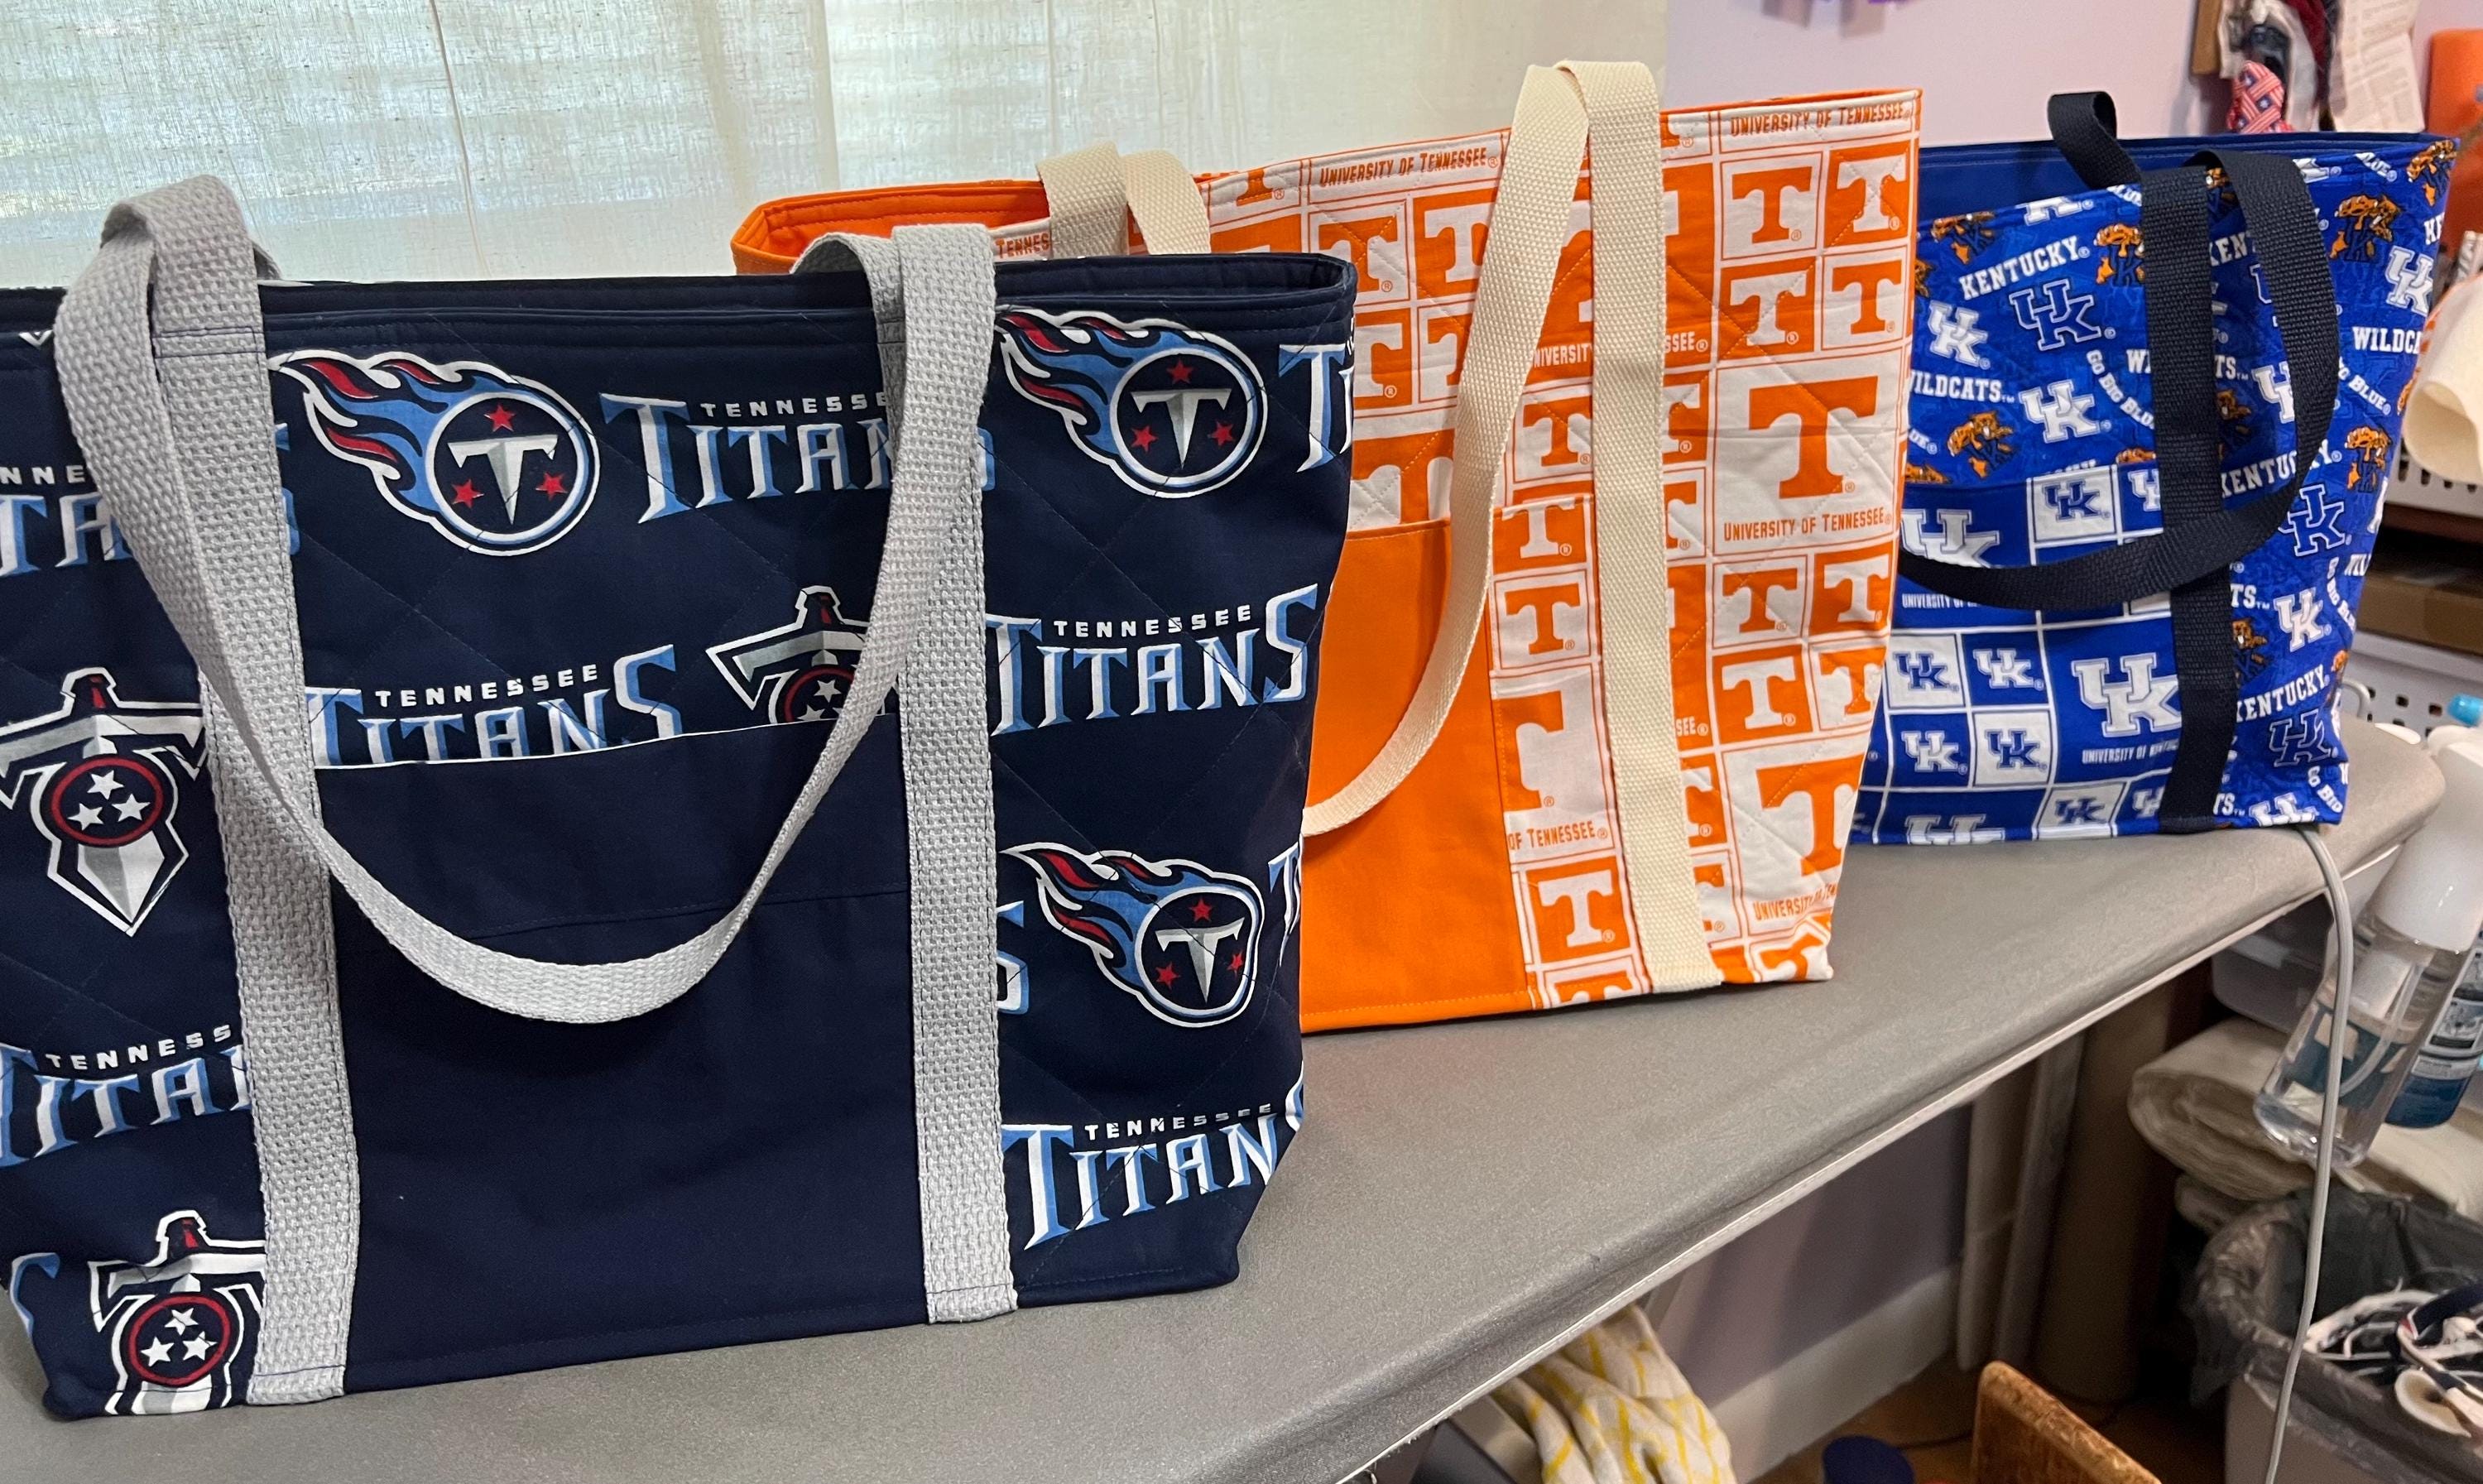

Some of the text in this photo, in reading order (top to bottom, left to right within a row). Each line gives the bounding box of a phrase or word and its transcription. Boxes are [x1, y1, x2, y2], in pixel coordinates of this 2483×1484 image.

[1731, 102, 1904, 137] UNIVERSITY OF TENNESSEE
[1319, 147, 1487, 187] UNIVERSITY OF TENNESSEE
[995, 233, 1049, 258] TENNES
[1959, 235, 2078, 300] KENTUCKY
[1724, 507, 1885, 541] UNIVERSITY OF TENNESSEE
[1054, 604, 1251, 638] TENNESSEE
[986, 584, 1318, 736] TITANS
[305, 645, 682, 766] TITANS
[376, 665, 598, 708] TENNESSEE
[1526, 820, 1596, 848] TENNESSEE
[46, 1025, 232, 1071] TENNESS
[1085, 1103, 1271, 1141] TENNESSEE
